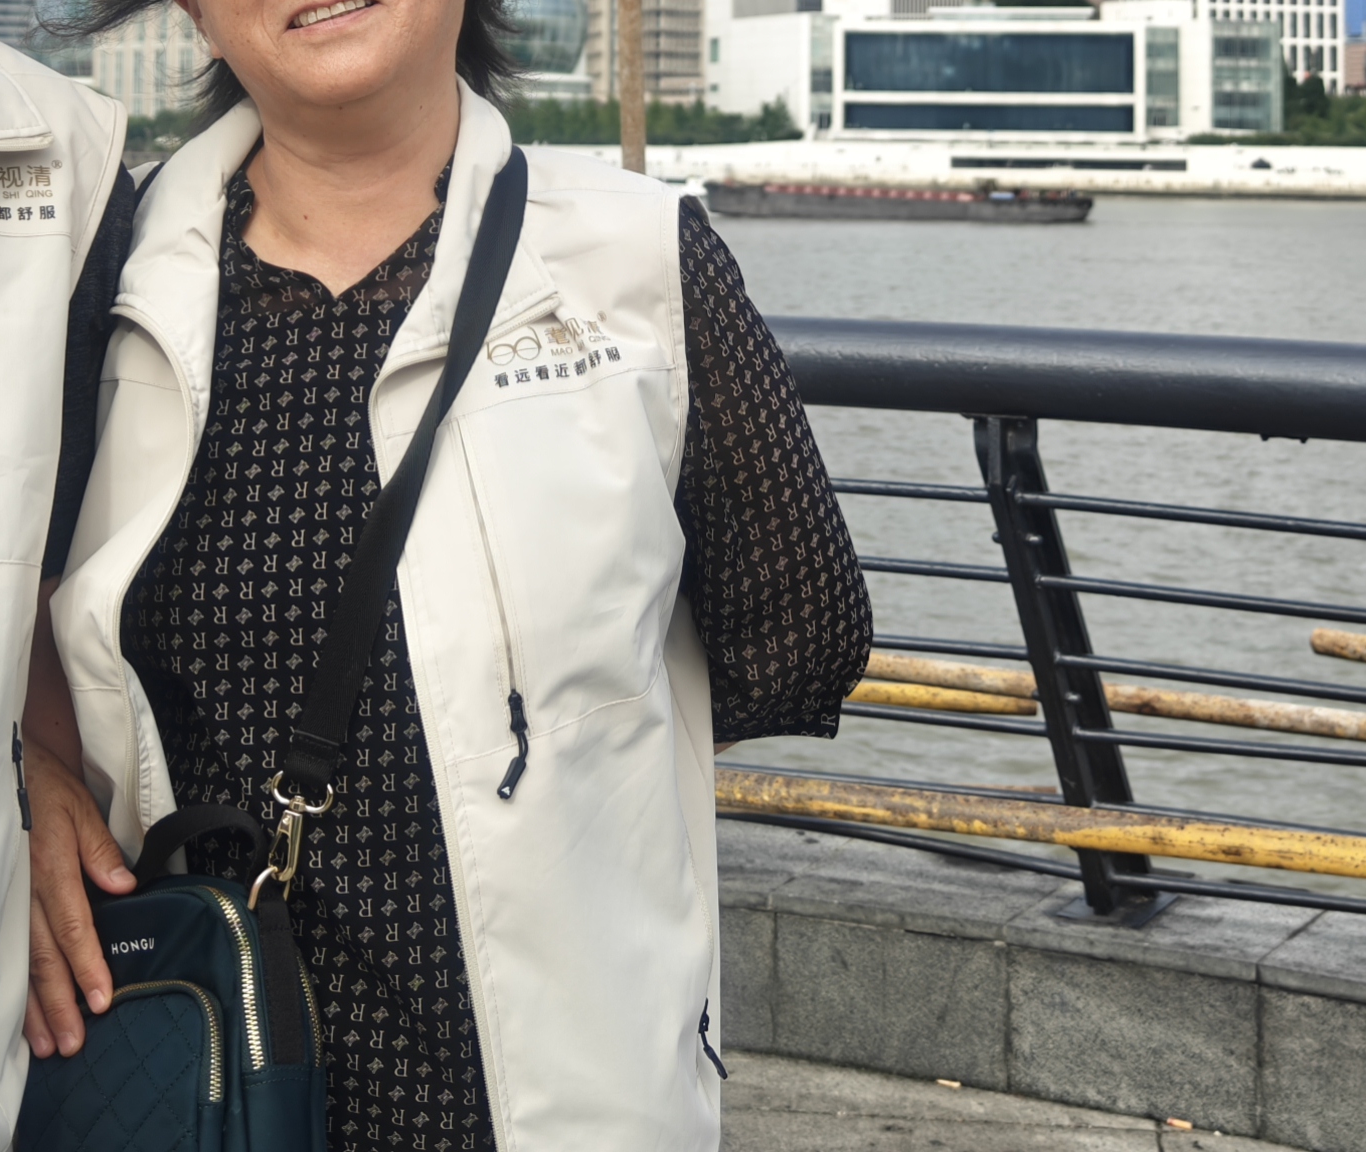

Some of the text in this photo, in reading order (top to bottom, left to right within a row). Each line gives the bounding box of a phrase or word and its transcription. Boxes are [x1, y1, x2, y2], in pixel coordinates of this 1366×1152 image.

[2, 190, 20, 199] SHI
[25, 189, 53, 198] QING
[551, 347, 573, 356] MAO
[494, 346, 621, 388] 看远看近都舒服
[111, 937, 155, 955] HONGU
